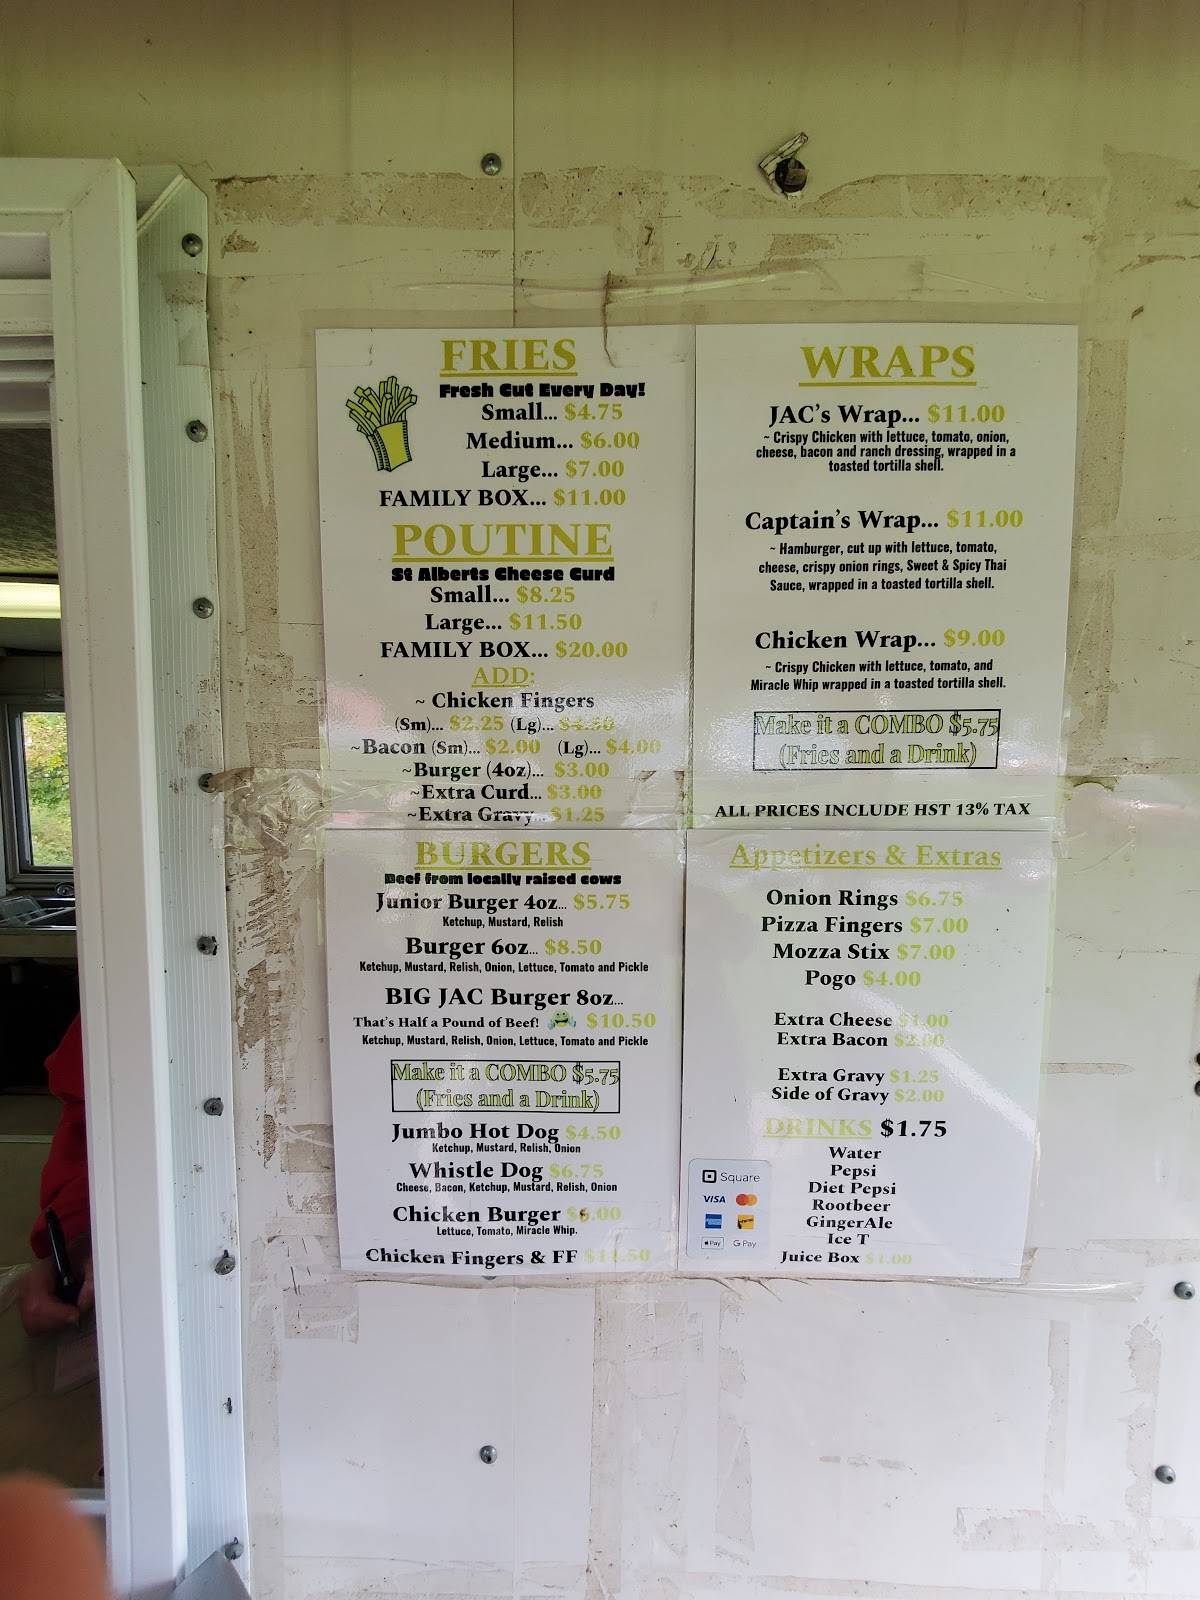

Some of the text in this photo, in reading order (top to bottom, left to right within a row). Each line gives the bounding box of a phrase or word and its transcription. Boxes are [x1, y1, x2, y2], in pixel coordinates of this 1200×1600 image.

[440, 339, 576, 371] FRIES
[801, 345, 976, 379] WRAPS
[440, 383, 645, 398] Fresh Cut Every Day!
[564, 402, 623, 421] $4.75
[768, 404, 1004, 428] JAC's $11.00
[580, 432, 640, 449] $6.00
[773, 431, 1009, 445] Crispy Chicken with lettuce, tomato, onion,
[565, 460, 624, 478] $7.00
[828, 460, 944, 471] toasted tortilla shell.
[380, 488, 625, 506] FAMILY $11.00
[745, 509, 1024, 535] Captain's $11.00
[392, 523, 613, 556] POUTINE
[392, 567, 615, 581] St Alberts Cheese Curd
[770, 577, 995, 592] Sauce, wrapped in toasted tortilla shell.
[517, 585, 576, 604] $8.25
[509, 613, 582, 631] $11.50
[755, 629, 1006, 649] Chicken $9.00
[380, 642, 472, 657] FAMILY
[555, 641, 629, 658] $20.00
[472, 667, 535, 684] ADD:
[432, 692, 595, 712] Chicken Fingers
[449, 716, 504, 732] $2.25
[485, 738, 662, 755] $2.00 $4.00
[554, 762, 610, 778] $3.00
[547, 784, 603, 800] $3.00
[551, 806, 605, 825] $1.25
[715, 802, 1031, 817] ALL PRICES INCLUDE HST 13% TAX
[415, 841, 590, 867] BURGERS
[729, 843, 1002, 871] Appetizers Extras
[385, 873, 621, 886] Beef from locally raised cows
[376, 893, 630, 914] Junior Burger $5.75
[766, 889, 964, 910] Onion Rings $6.75
[443, 916, 564, 928] Ketchup, Mustard, Relish
[761, 916, 969, 937] Pizza Fingers $7.00
[405, 937, 603, 960] Burger $8.50
[772, 943, 956, 960] Mozza Stix $7.00
[360, 961, 649, 973] Ketchup, Mustard, Relish, Onion, Lettuce, Tomato and Pickle
[804, 970, 921, 990] Pogo $4.00
[385, 988, 571, 1010] BIG JAC Burger
[354, 1013, 657, 1029] That's Half Pound of Beef! $10.50
[774, 1012, 893, 1026] Extra Cheese
[777, 1032, 888, 1046] Extra Bacon
[392, 1062, 620, 1086] Make it COMBO $5.75
[777, 1068, 940, 1084] Extra Gravy $1.25
[416, 1088, 600, 1112] (Fries and Drink)
[771, 1086, 945, 1105] Side of Gravy $2.00
[392, 1123, 621, 1143] Jumbo Hot Dog $4.50
[764, 1118, 947, 1138] DRINKS $1.75
[829, 1147, 882, 1159] Water
[410, 1161, 604, 1183] Whistle Dog $6.75
[720, 1173, 760, 1183] Square
[830, 1165, 877, 1180] Pepsi
[808, 1181, 897, 1197] Diet Pepsi
[812, 1199, 891, 1211] Rootbeer
[393, 1206, 561, 1226] Chicken Burger
[806, 1216, 893, 1231] GingerAle
[436, 1226, 578, 1237] Lettuce, Tomato, Miracle Whip.
[827, 1234, 870, 1244] Ice T
[743, 1240, 757, 1248] Pay
[365, 1248, 578, 1269] Chicken Fingers FF
[780, 1251, 860, 1263] Juice Box
